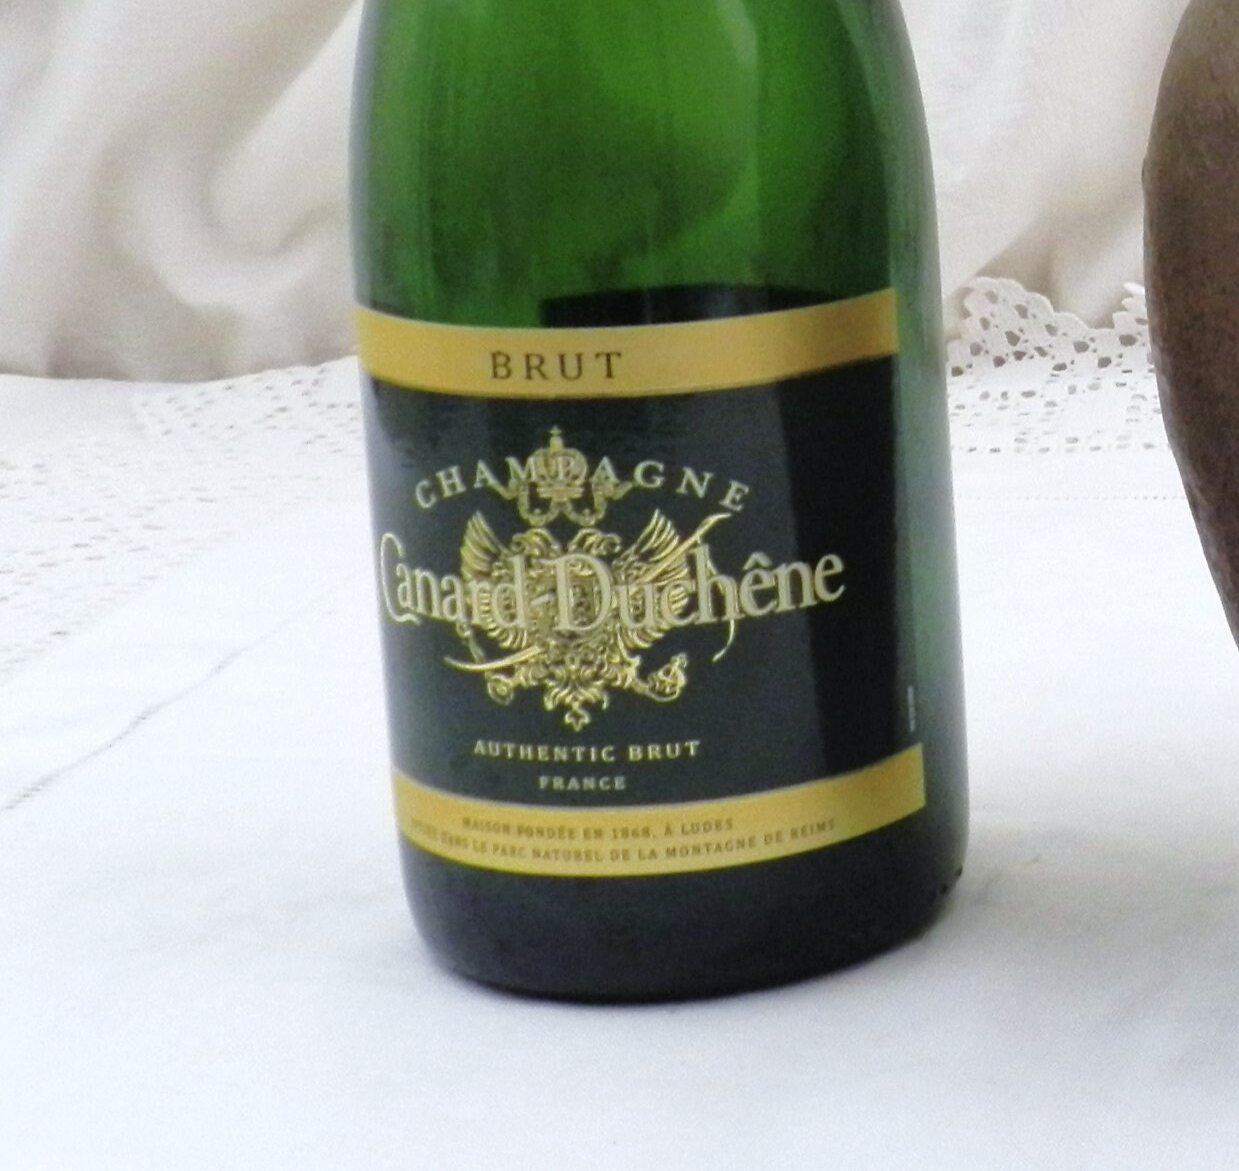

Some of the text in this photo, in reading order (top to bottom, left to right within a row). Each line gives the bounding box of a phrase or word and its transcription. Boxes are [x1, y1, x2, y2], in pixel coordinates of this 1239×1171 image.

[490, 351, 622, 380] BRUT
[414, 455, 751, 513] CHAMPAGNE
[380, 532, 846, 631] Canard-Duchêne
[474, 739, 700, 763] AUTHENTIC BRUT
[539, 775, 627, 791] FRANCE
[681, 818, 733, 836] LUDES
[493, 842, 527, 859] PARC
[532, 848, 604, 862] NATUREL
[610, 849, 630, 861] DE
[638, 849, 657, 860] LA
[666, 836, 757, 859] MONTAGNE
[764, 831, 783, 845] DE
